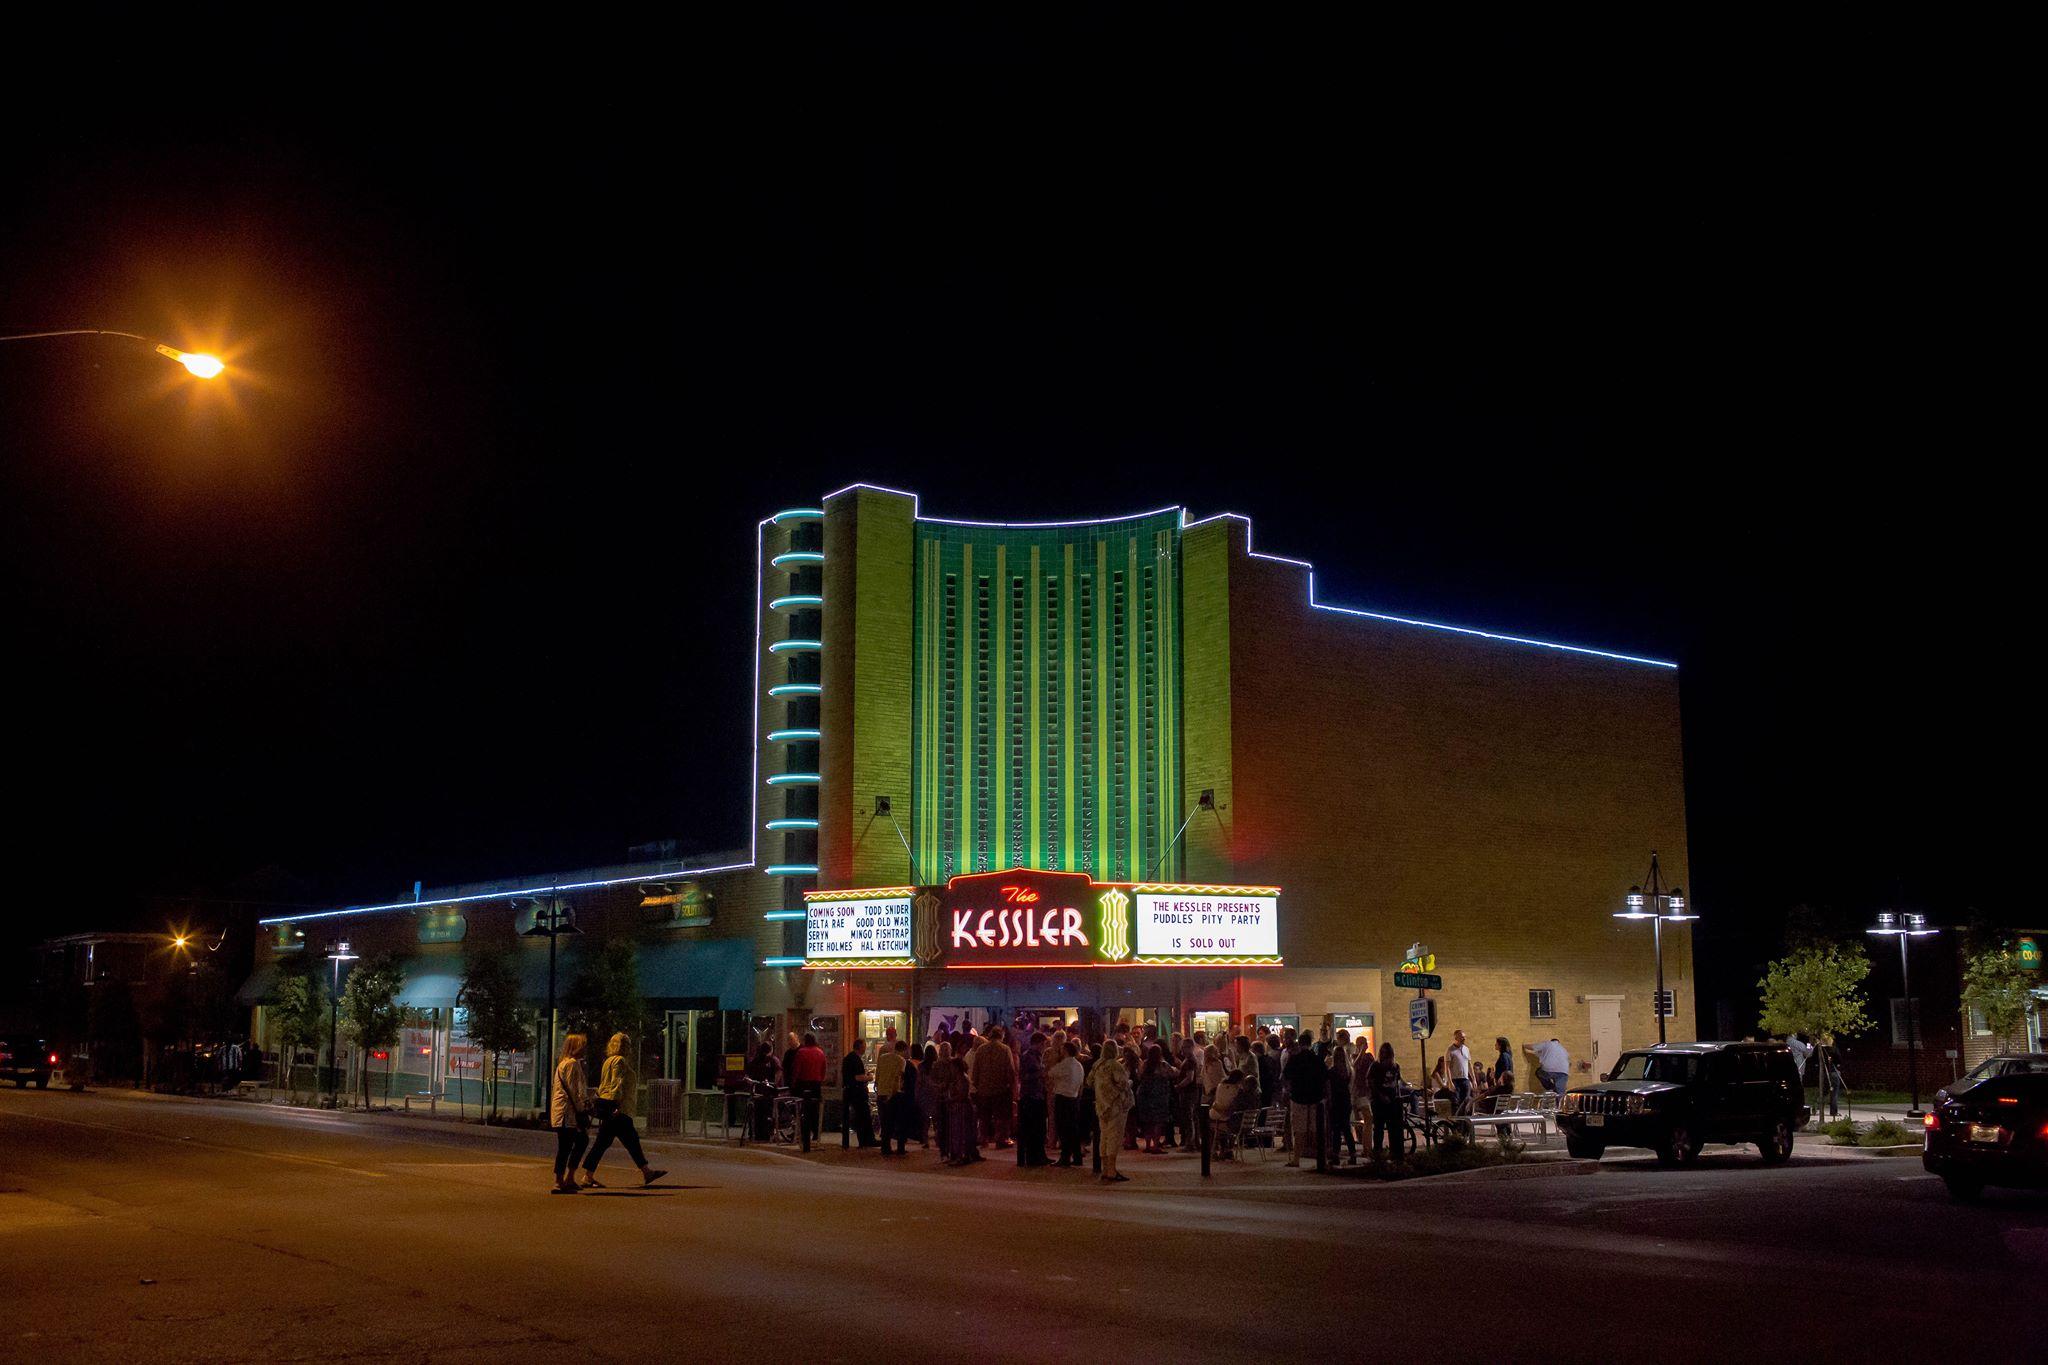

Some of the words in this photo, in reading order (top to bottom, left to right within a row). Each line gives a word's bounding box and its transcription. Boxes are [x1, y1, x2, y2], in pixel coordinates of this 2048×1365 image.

[1001, 886, 1039, 903] The
[809, 908, 834, 918] COMING
[837, 907, 855, 917] SOON
[864, 905, 882, 916] TODD
[885, 904, 909, 915] SNIDER
[1153, 901, 1169, 912] THE
[1173, 902, 1212, 912] KESSLER
[1217, 902, 1261, 913] PRESENTS
[808, 919, 829, 929] DELTA
[832, 918, 845, 928] RAE
[856, 917, 875, 928] GOOD
[877, 917, 891, 927] OLD
[893, 916, 909, 927] WAR
[1153, 914, 1193, 924] PUDDLES
[1202, 914, 1223, 924] PITY
[1231, 915, 1261, 925] PARTY
[851, 929, 873, 939] MINGO
[876, 928, 909, 939] FISHTRAP
[951, 908, 1089, 948] KESSLER
[808, 930, 829, 941] SERYN
[808, 942, 824, 952] PETE
[826, 941, 853, 951] HOLMES
[861, 941, 874, 951] HAL
[877, 940, 909, 951] KETCHUM
[1172, 938, 1181, 948] IS
[1190, 938, 1213, 948] SOLD
[1218, 938, 1236, 948] OUT
[1401, 974, 1429, 987] Clinton
